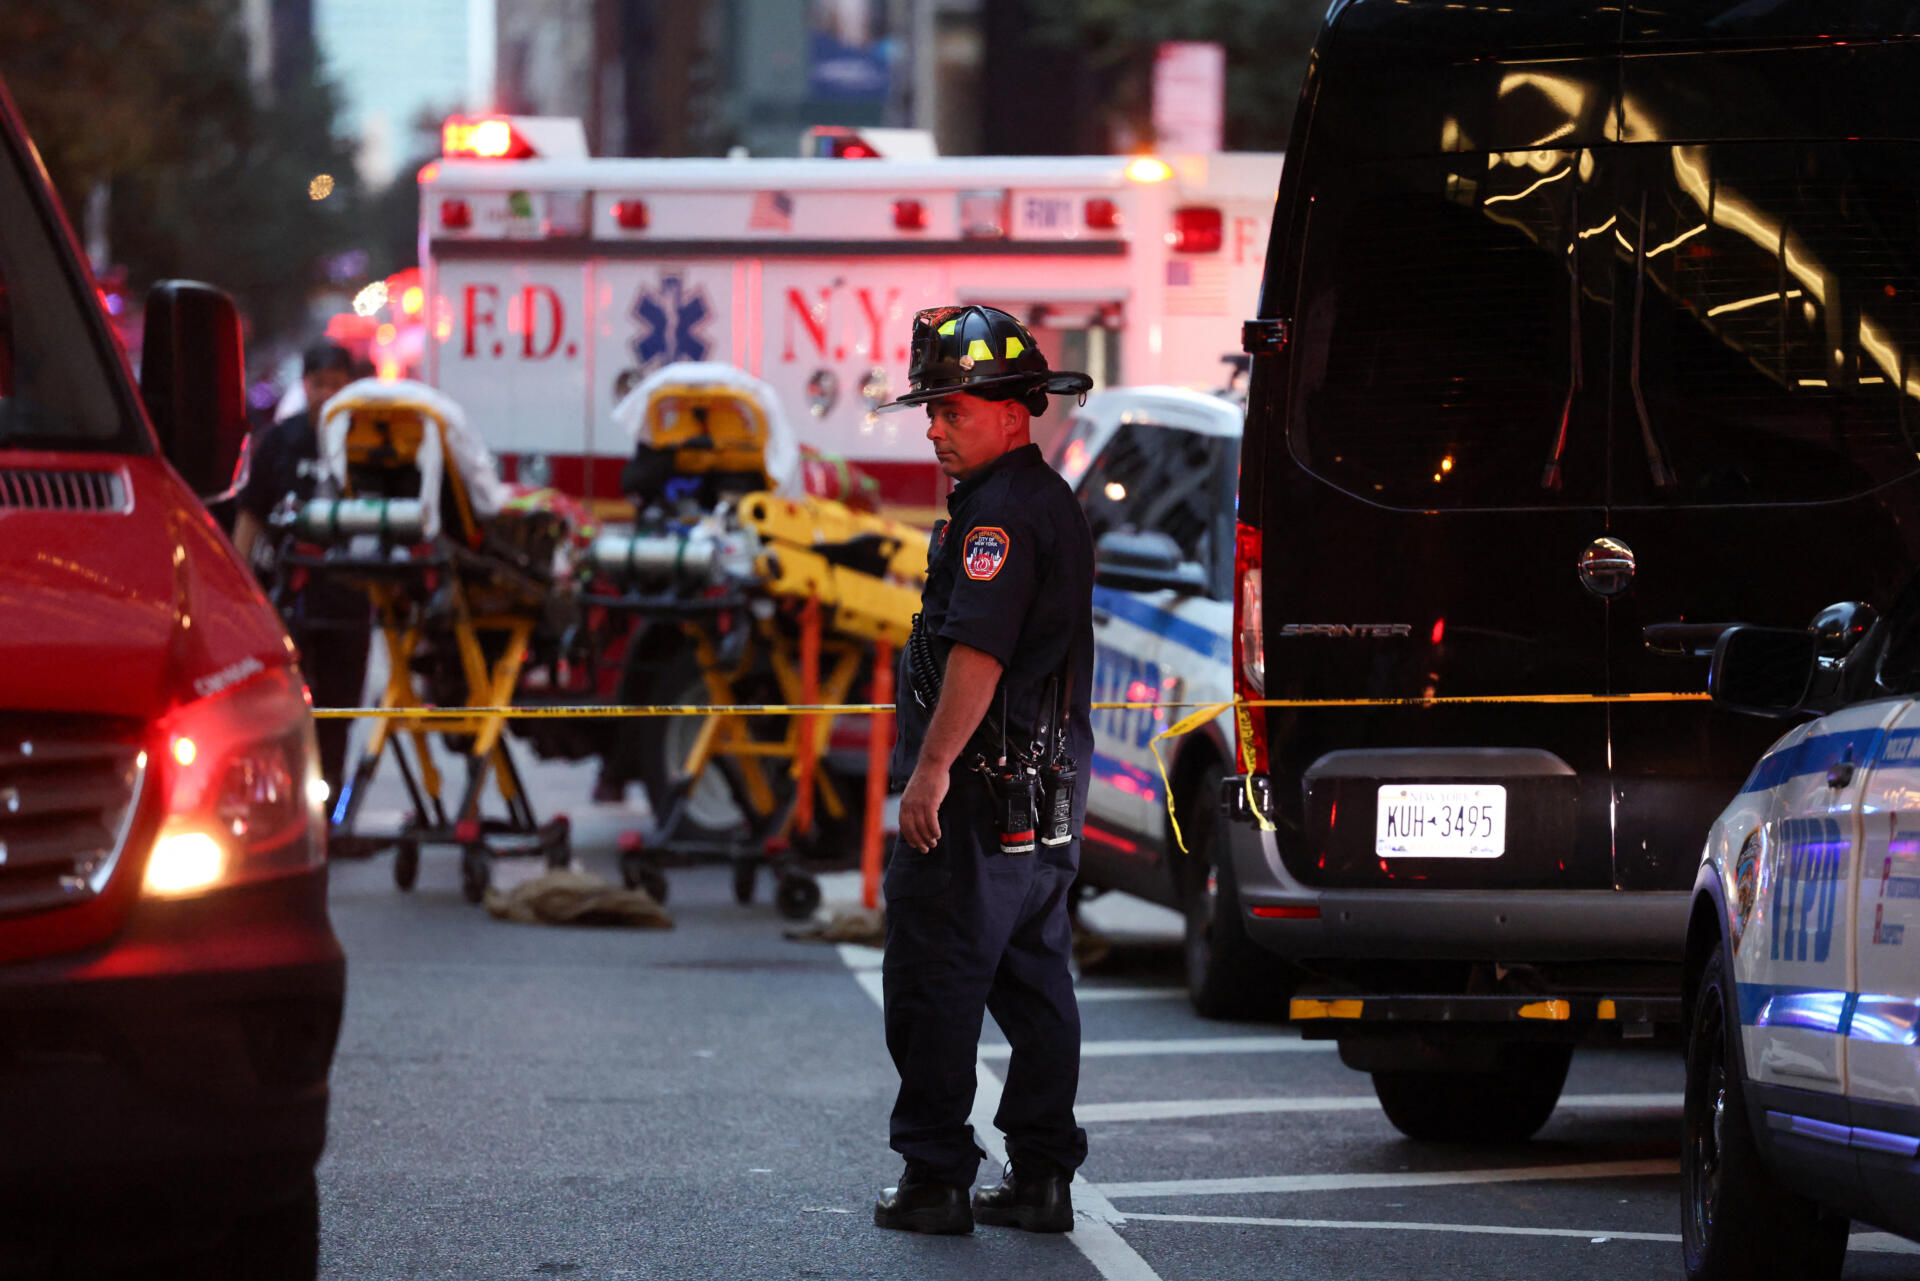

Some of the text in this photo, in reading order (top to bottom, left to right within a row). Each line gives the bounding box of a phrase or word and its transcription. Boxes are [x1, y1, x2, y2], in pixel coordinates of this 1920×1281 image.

[461, 283, 906, 363] F.D. N.Y.
[1280, 623, 1411, 637] SPRINTER
